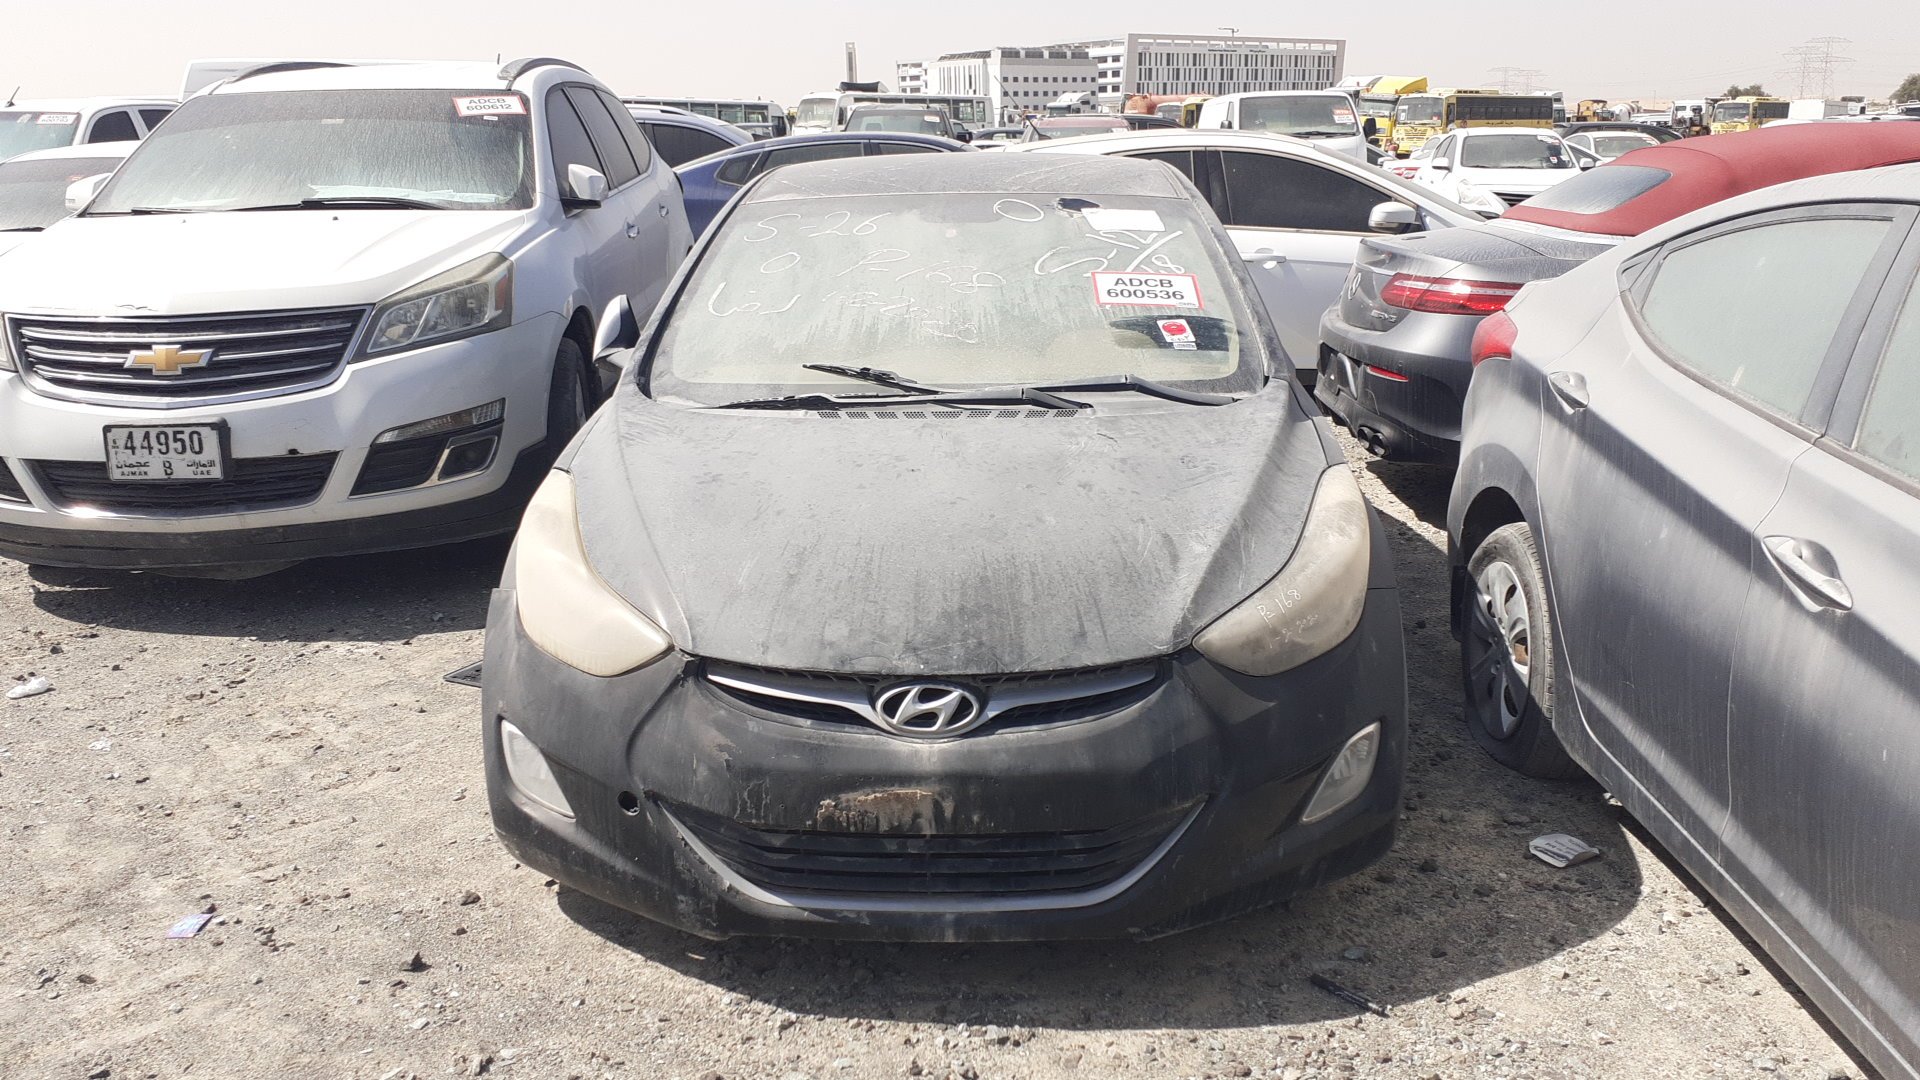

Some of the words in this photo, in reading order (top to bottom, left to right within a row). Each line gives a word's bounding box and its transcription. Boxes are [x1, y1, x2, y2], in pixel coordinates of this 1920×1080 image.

[466, 103, 513, 111] 600612
[1113, 277, 1174, 288] ADCB
[1106, 288, 1185, 300] 600536
[123, 430, 204, 456] 44950
